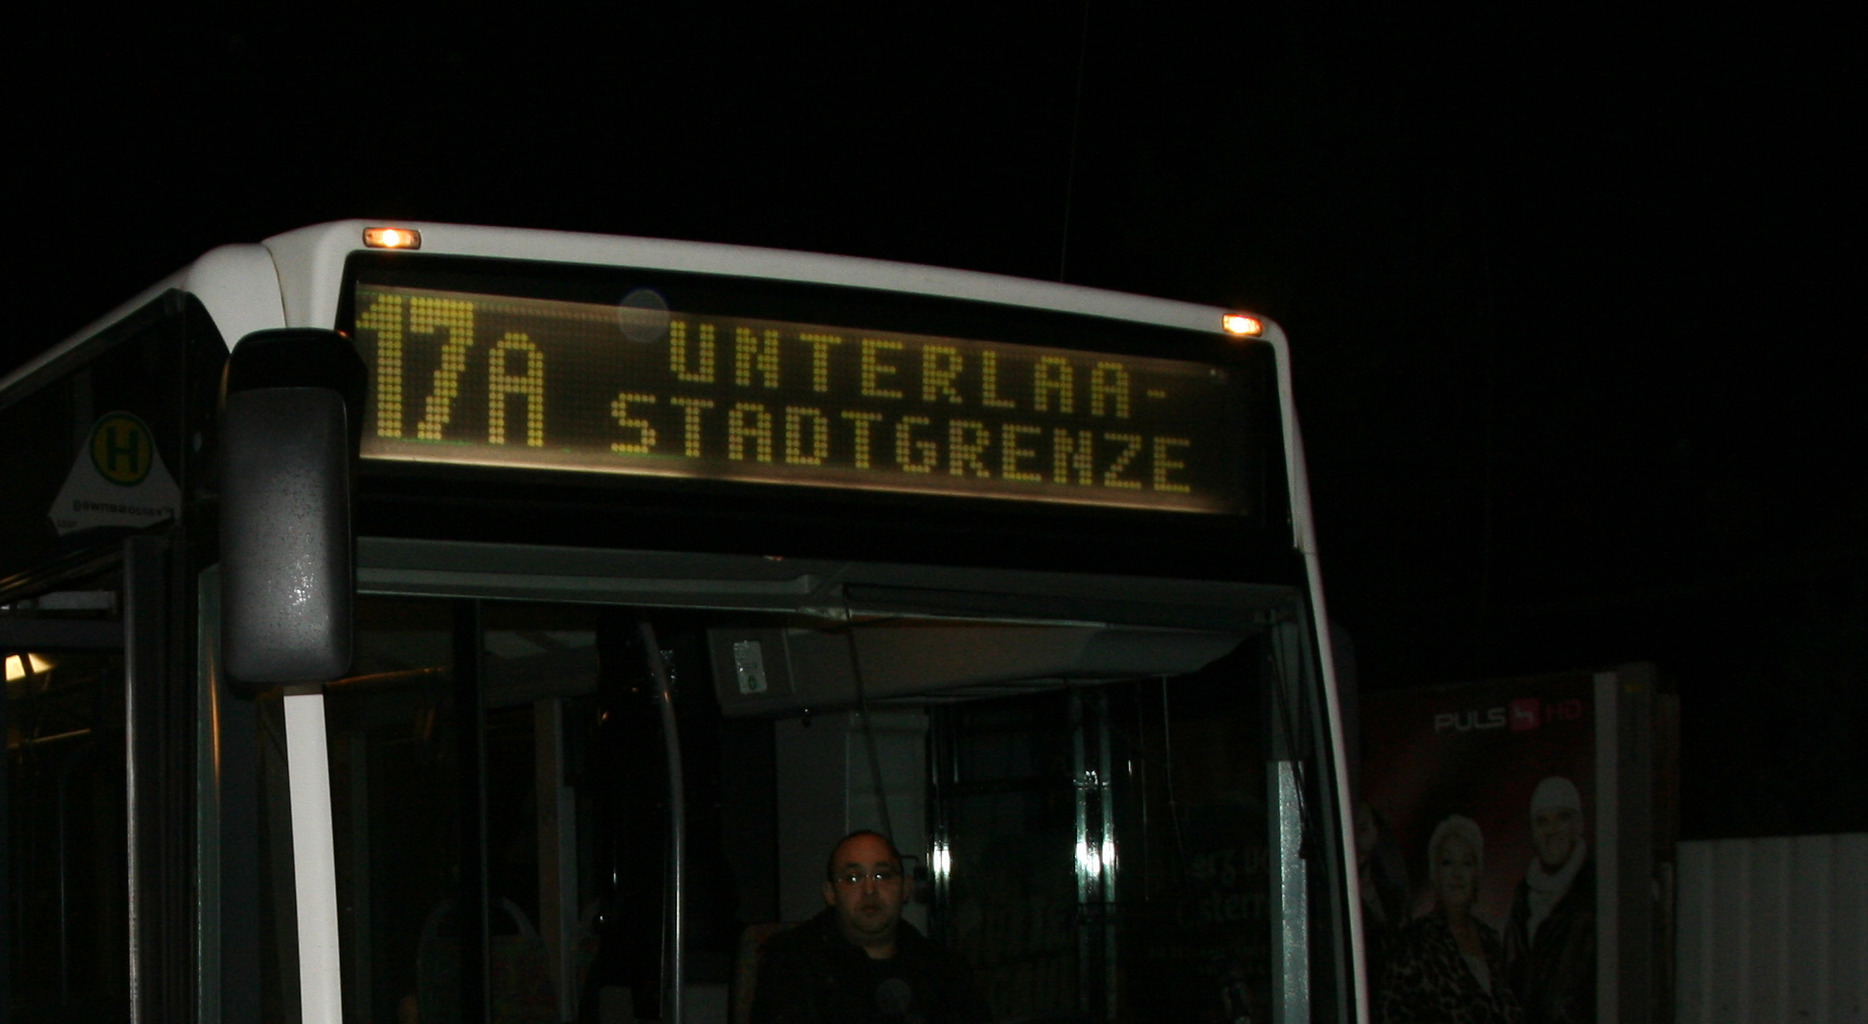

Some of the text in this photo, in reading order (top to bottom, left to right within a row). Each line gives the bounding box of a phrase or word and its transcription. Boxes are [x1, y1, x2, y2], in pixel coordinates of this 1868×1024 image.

[356, 294, 544, 447] 17A
[669, 319, 1167, 418] UNTERLAA-
[610, 392, 1192, 493] STADTGRENZE
[1434, 706, 1507, 735] PULS
